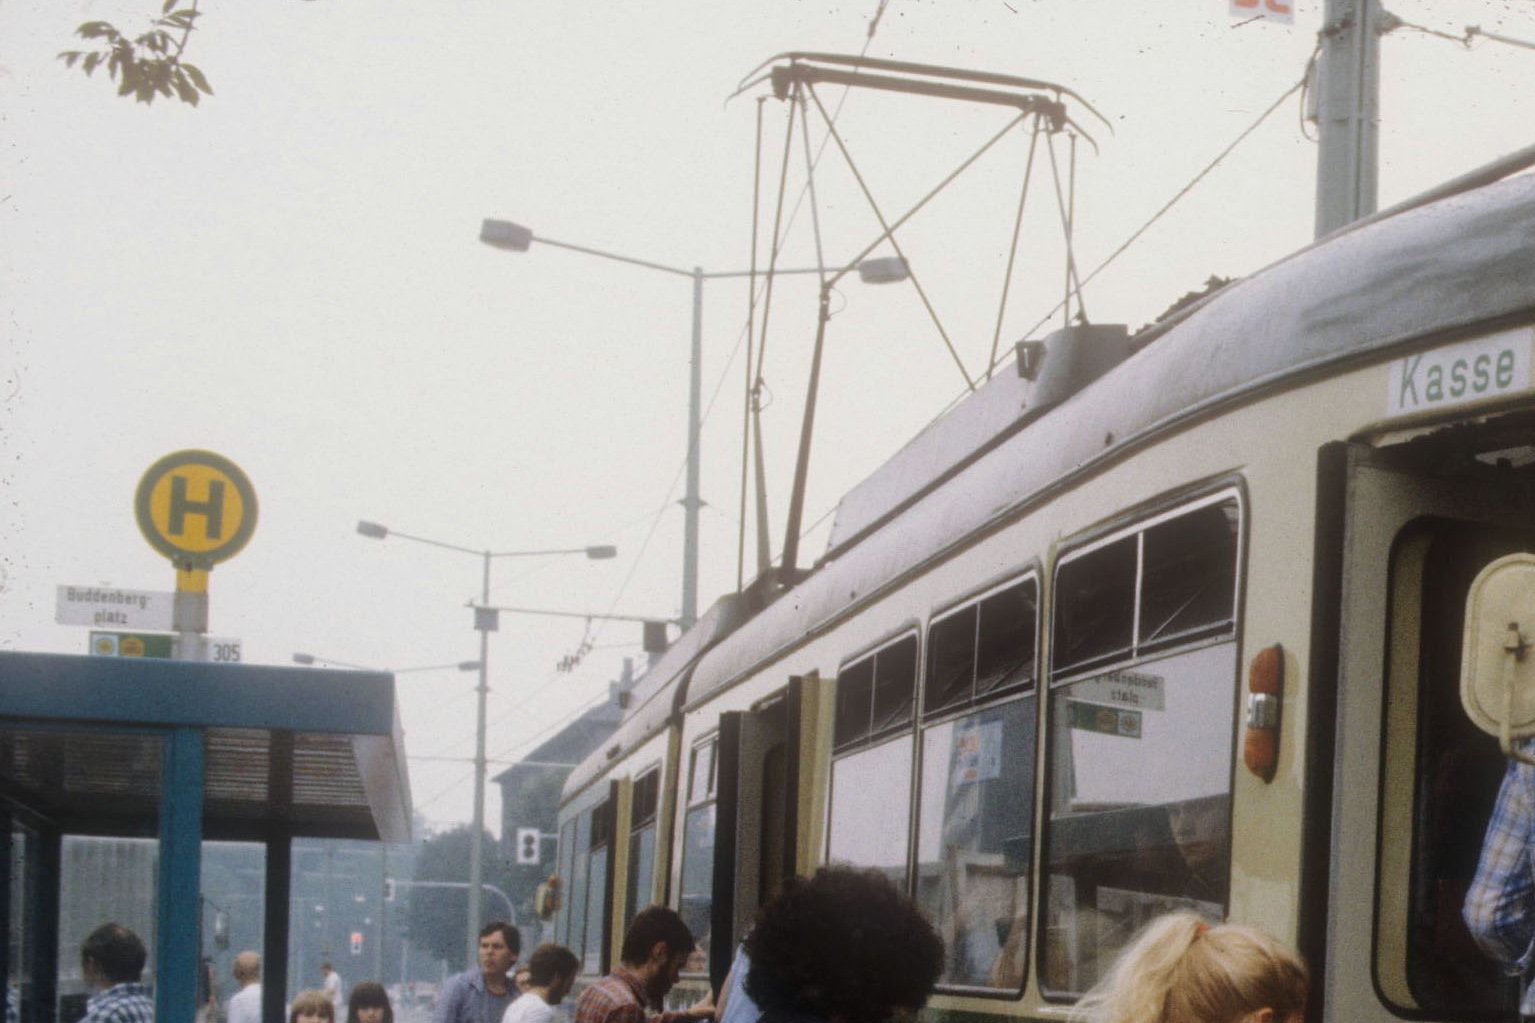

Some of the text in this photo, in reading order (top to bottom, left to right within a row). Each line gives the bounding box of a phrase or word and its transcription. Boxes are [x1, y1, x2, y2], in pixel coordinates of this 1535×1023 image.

[1400, 350, 1515, 408] Kasse
[168, 475, 225, 540] H
[94, 611, 128, 625] platz
[213, 643, 241, 661] 305
